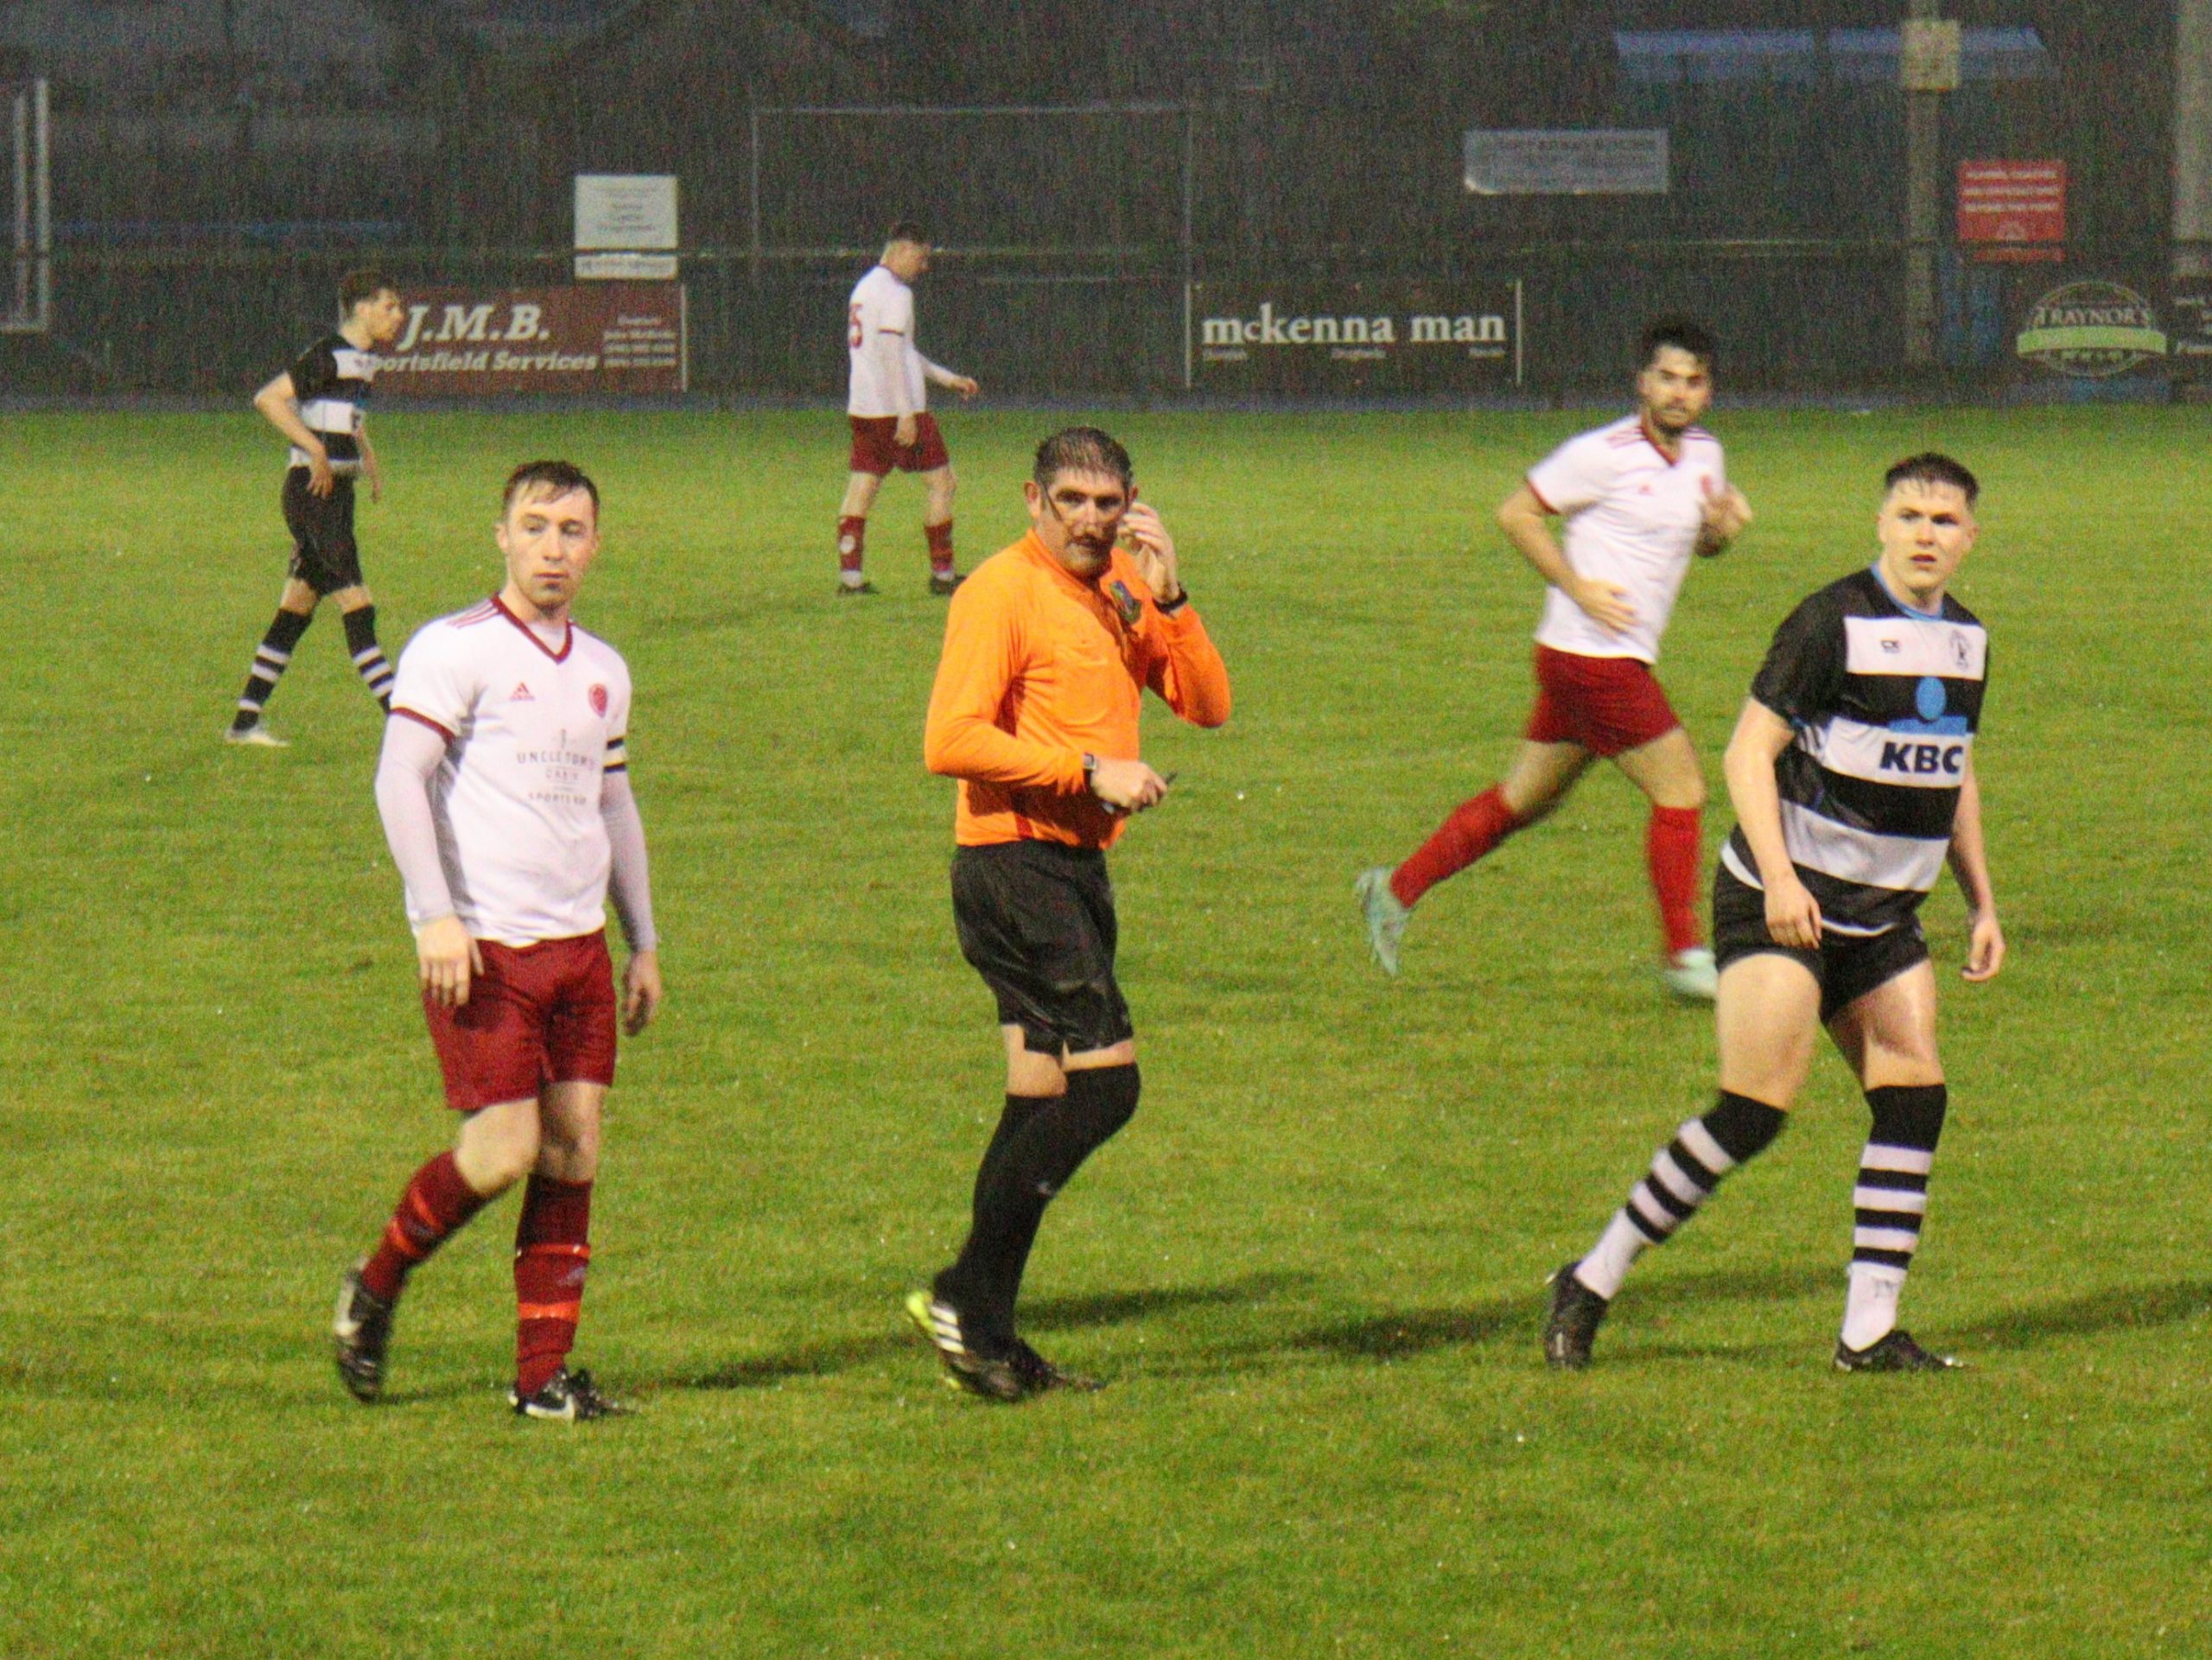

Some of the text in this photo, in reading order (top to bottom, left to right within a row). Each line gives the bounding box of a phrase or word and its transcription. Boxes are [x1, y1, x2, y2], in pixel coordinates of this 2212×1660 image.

[396, 303, 550, 351] J.M.B.
[1201, 302, 1506, 343] mckenna man
[373, 350, 489, 371] portsfield
[492, 348, 599, 371] Services
[1880, 741, 1964, 775] KBC
